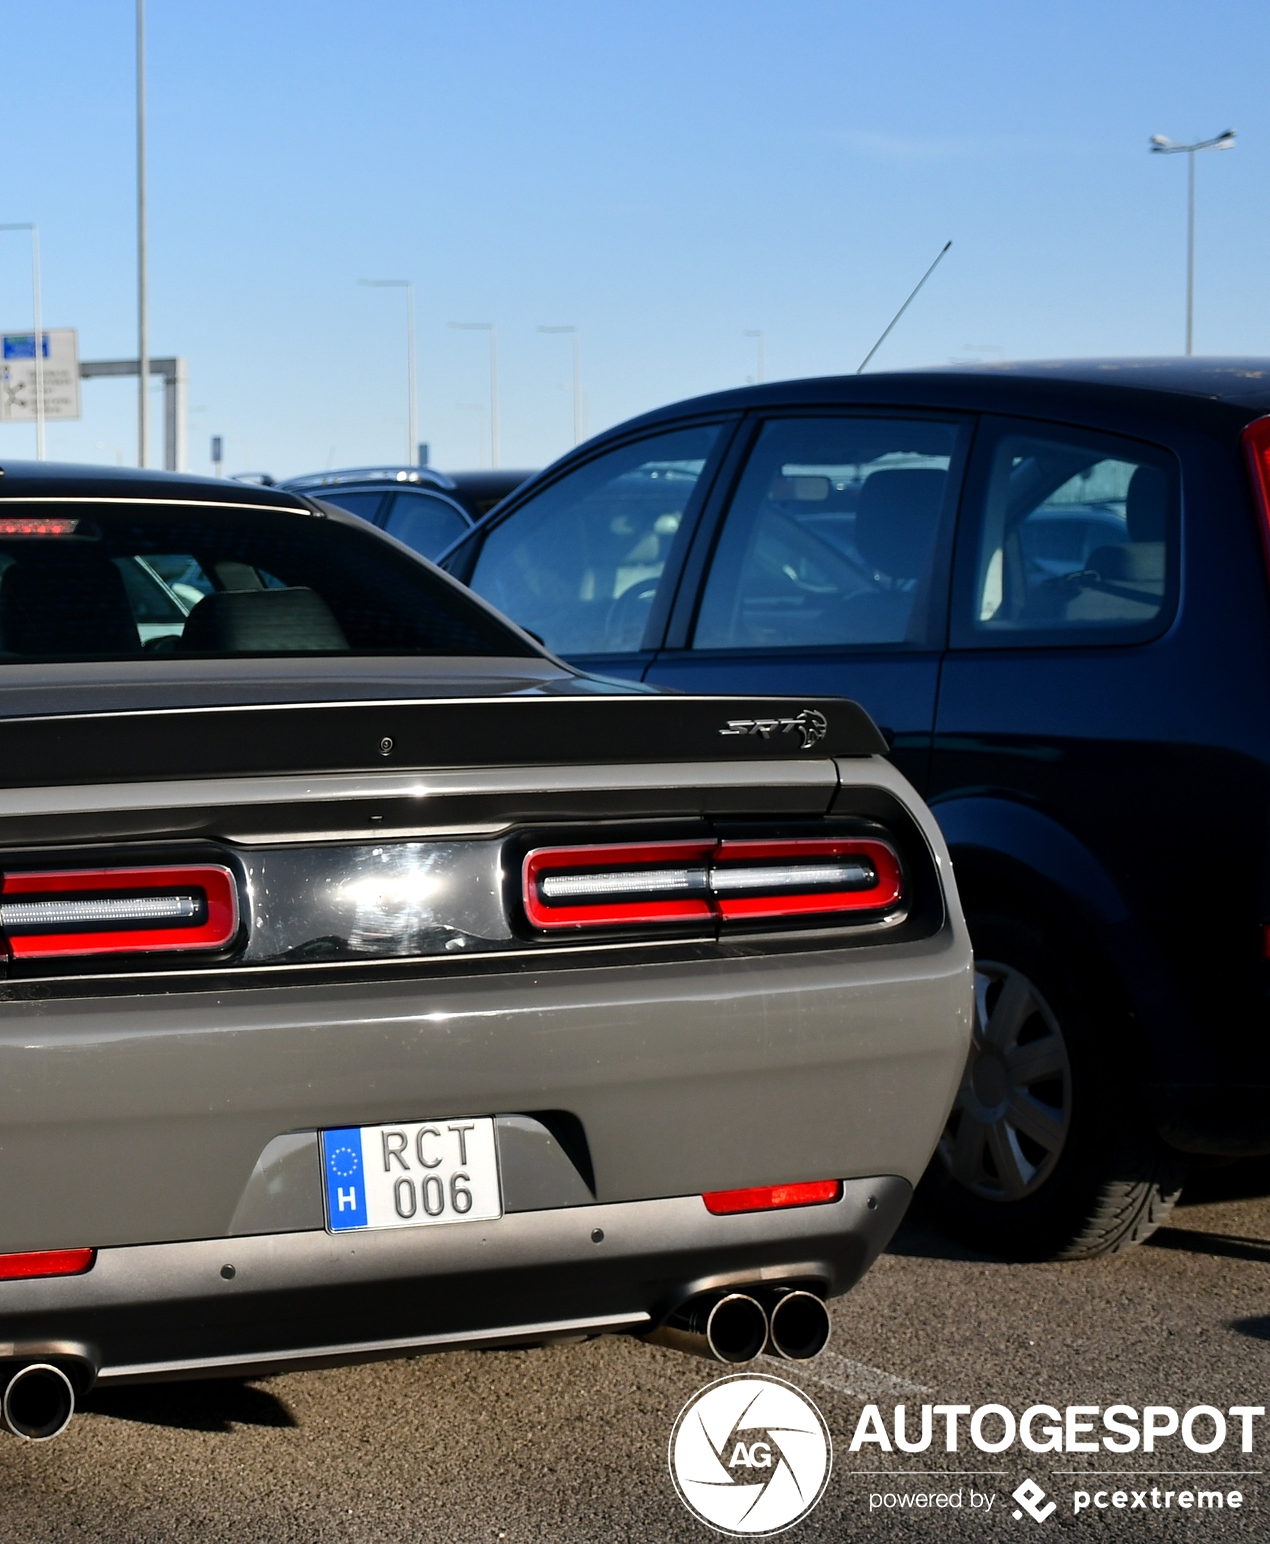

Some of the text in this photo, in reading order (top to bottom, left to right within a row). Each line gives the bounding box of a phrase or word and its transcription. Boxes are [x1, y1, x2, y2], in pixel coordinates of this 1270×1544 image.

[719, 717, 806, 739] SRT
[381, 1123, 475, 1172] RCT
[337, 1186, 357, 1211] H
[393, 1170, 473, 1219] 006
